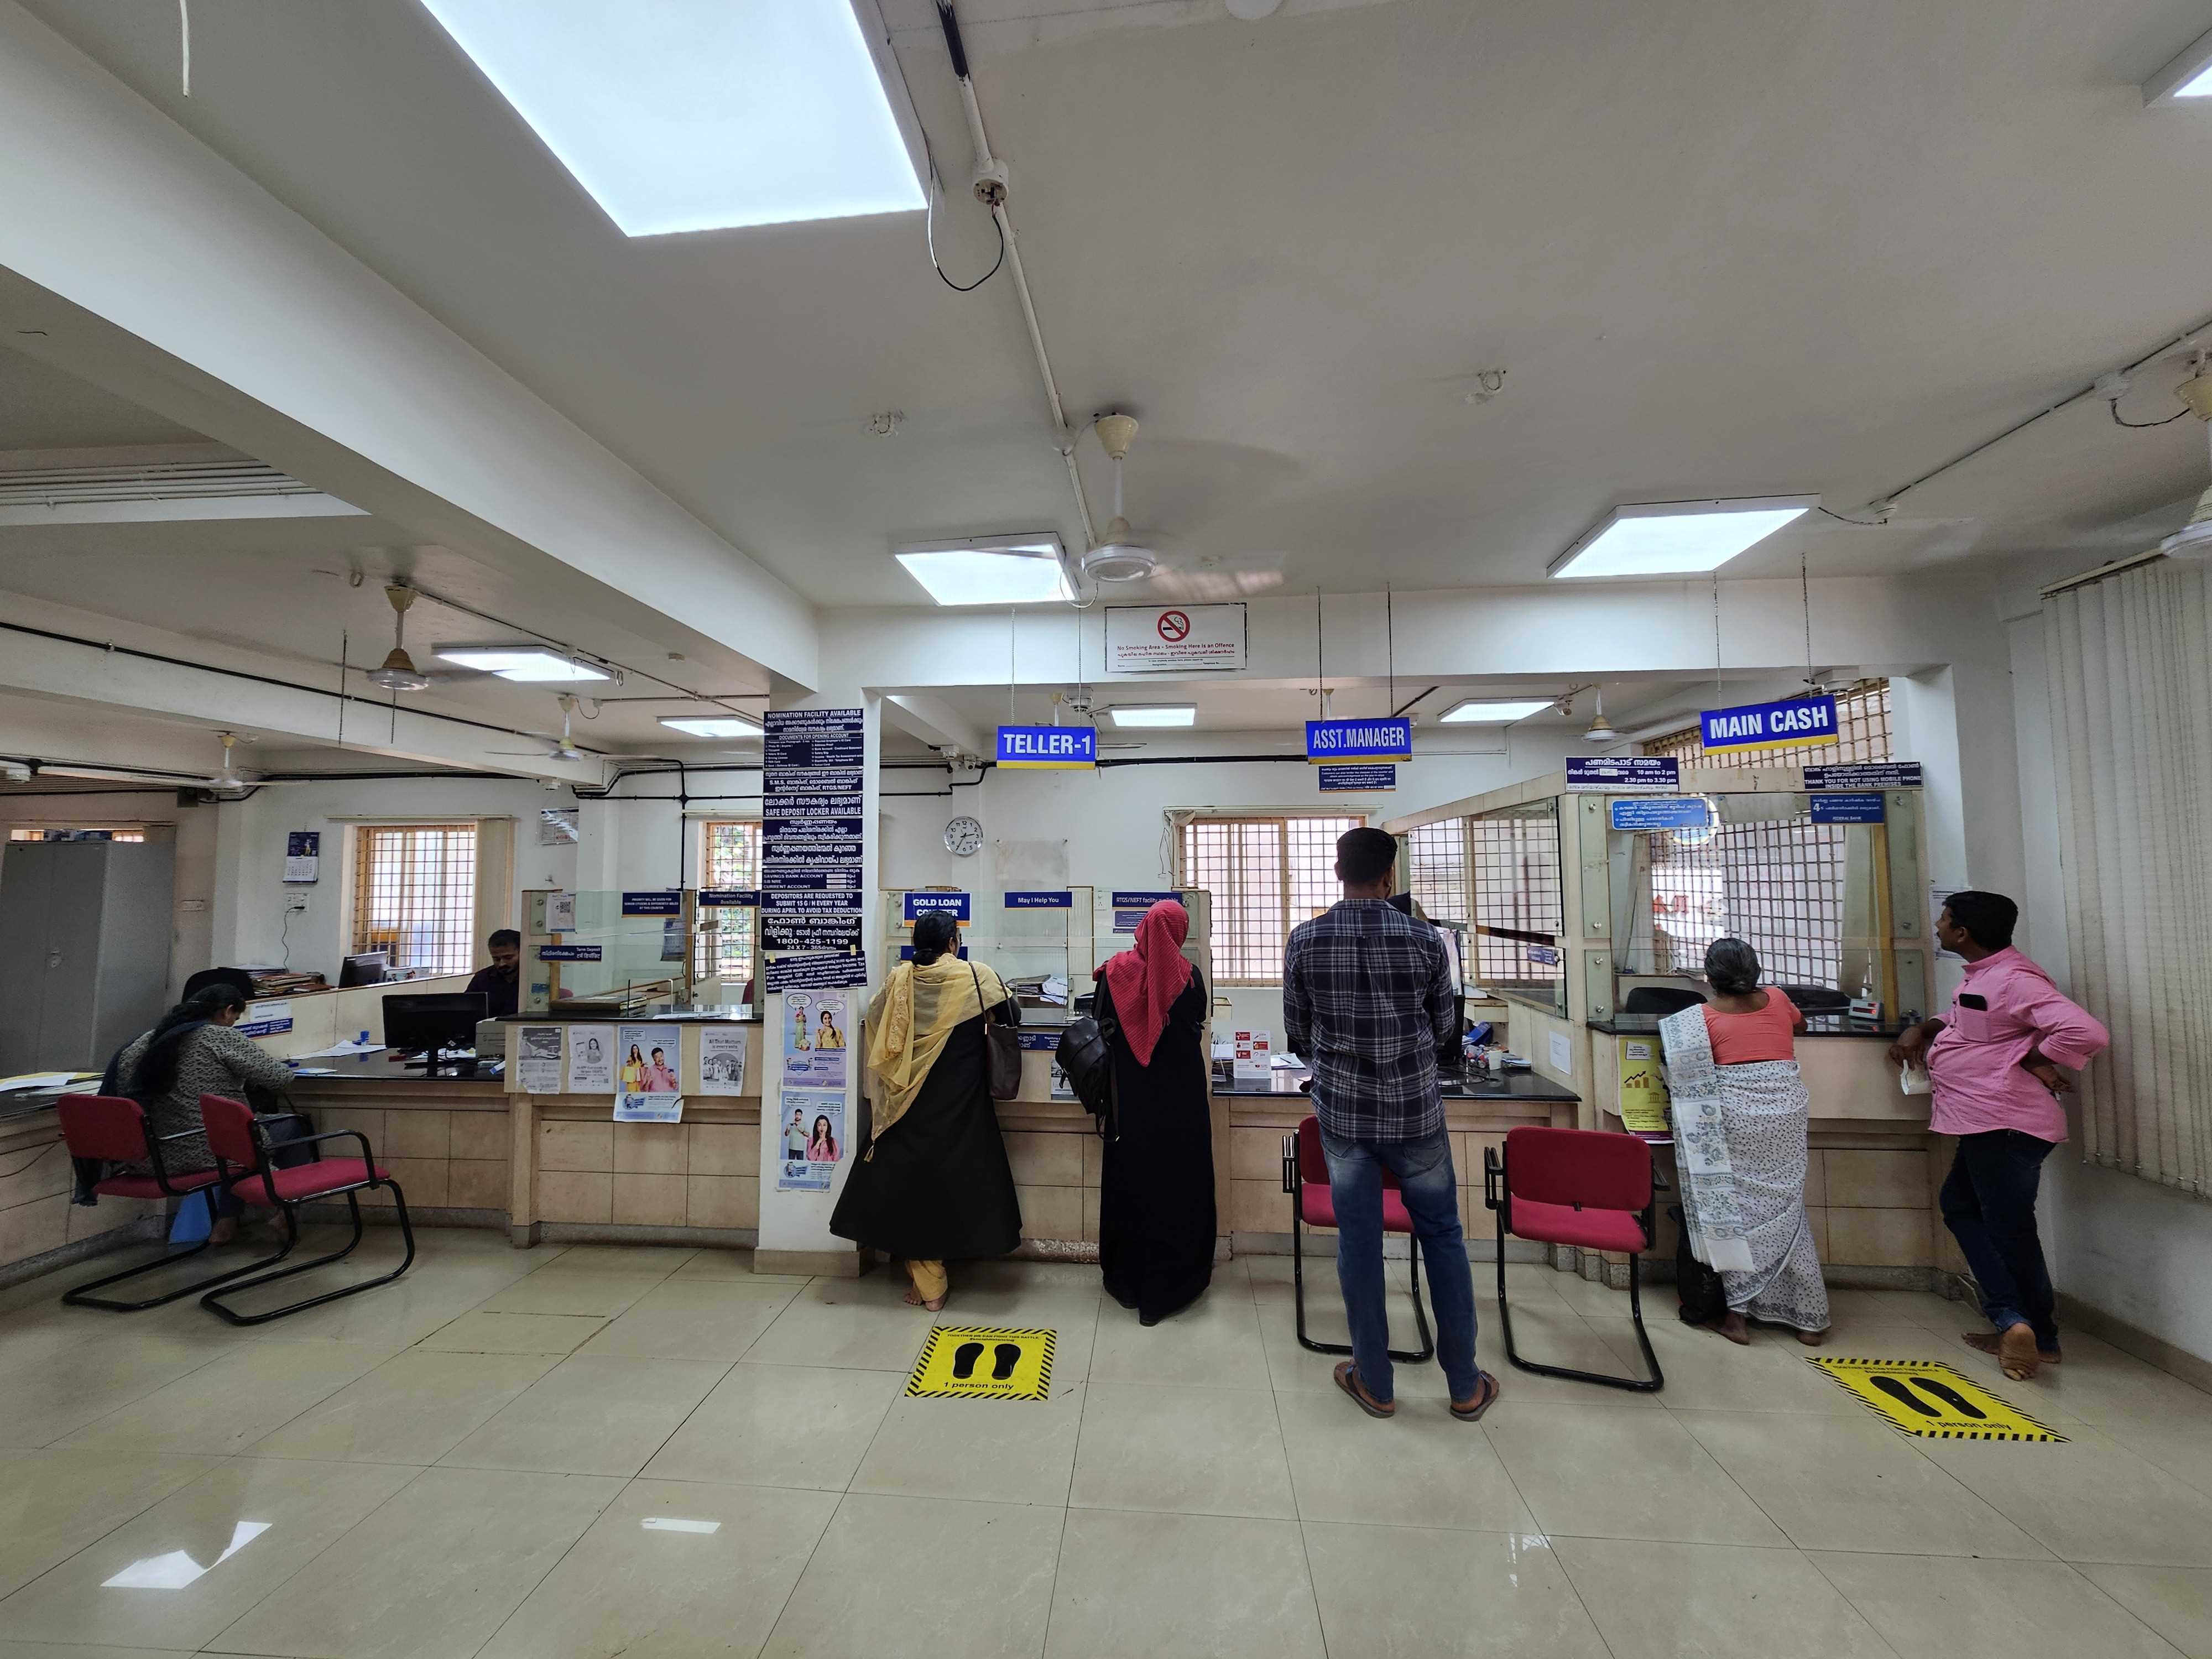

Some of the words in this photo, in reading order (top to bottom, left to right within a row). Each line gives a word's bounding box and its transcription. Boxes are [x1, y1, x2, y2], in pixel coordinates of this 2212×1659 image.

[1709, 713, 1763, 739] MAIN
[1770, 705, 1828, 733] CASH
[1003, 734, 1091, 754] TELLER-1
[1313, 727, 1405, 749] ASST.MANAGER
[796, 797, 828, 806] സൗകര്യം
[831, 795, 862, 806] ലഭ്യമാണ്
[831, 807, 861, 815] AVAILABLE
